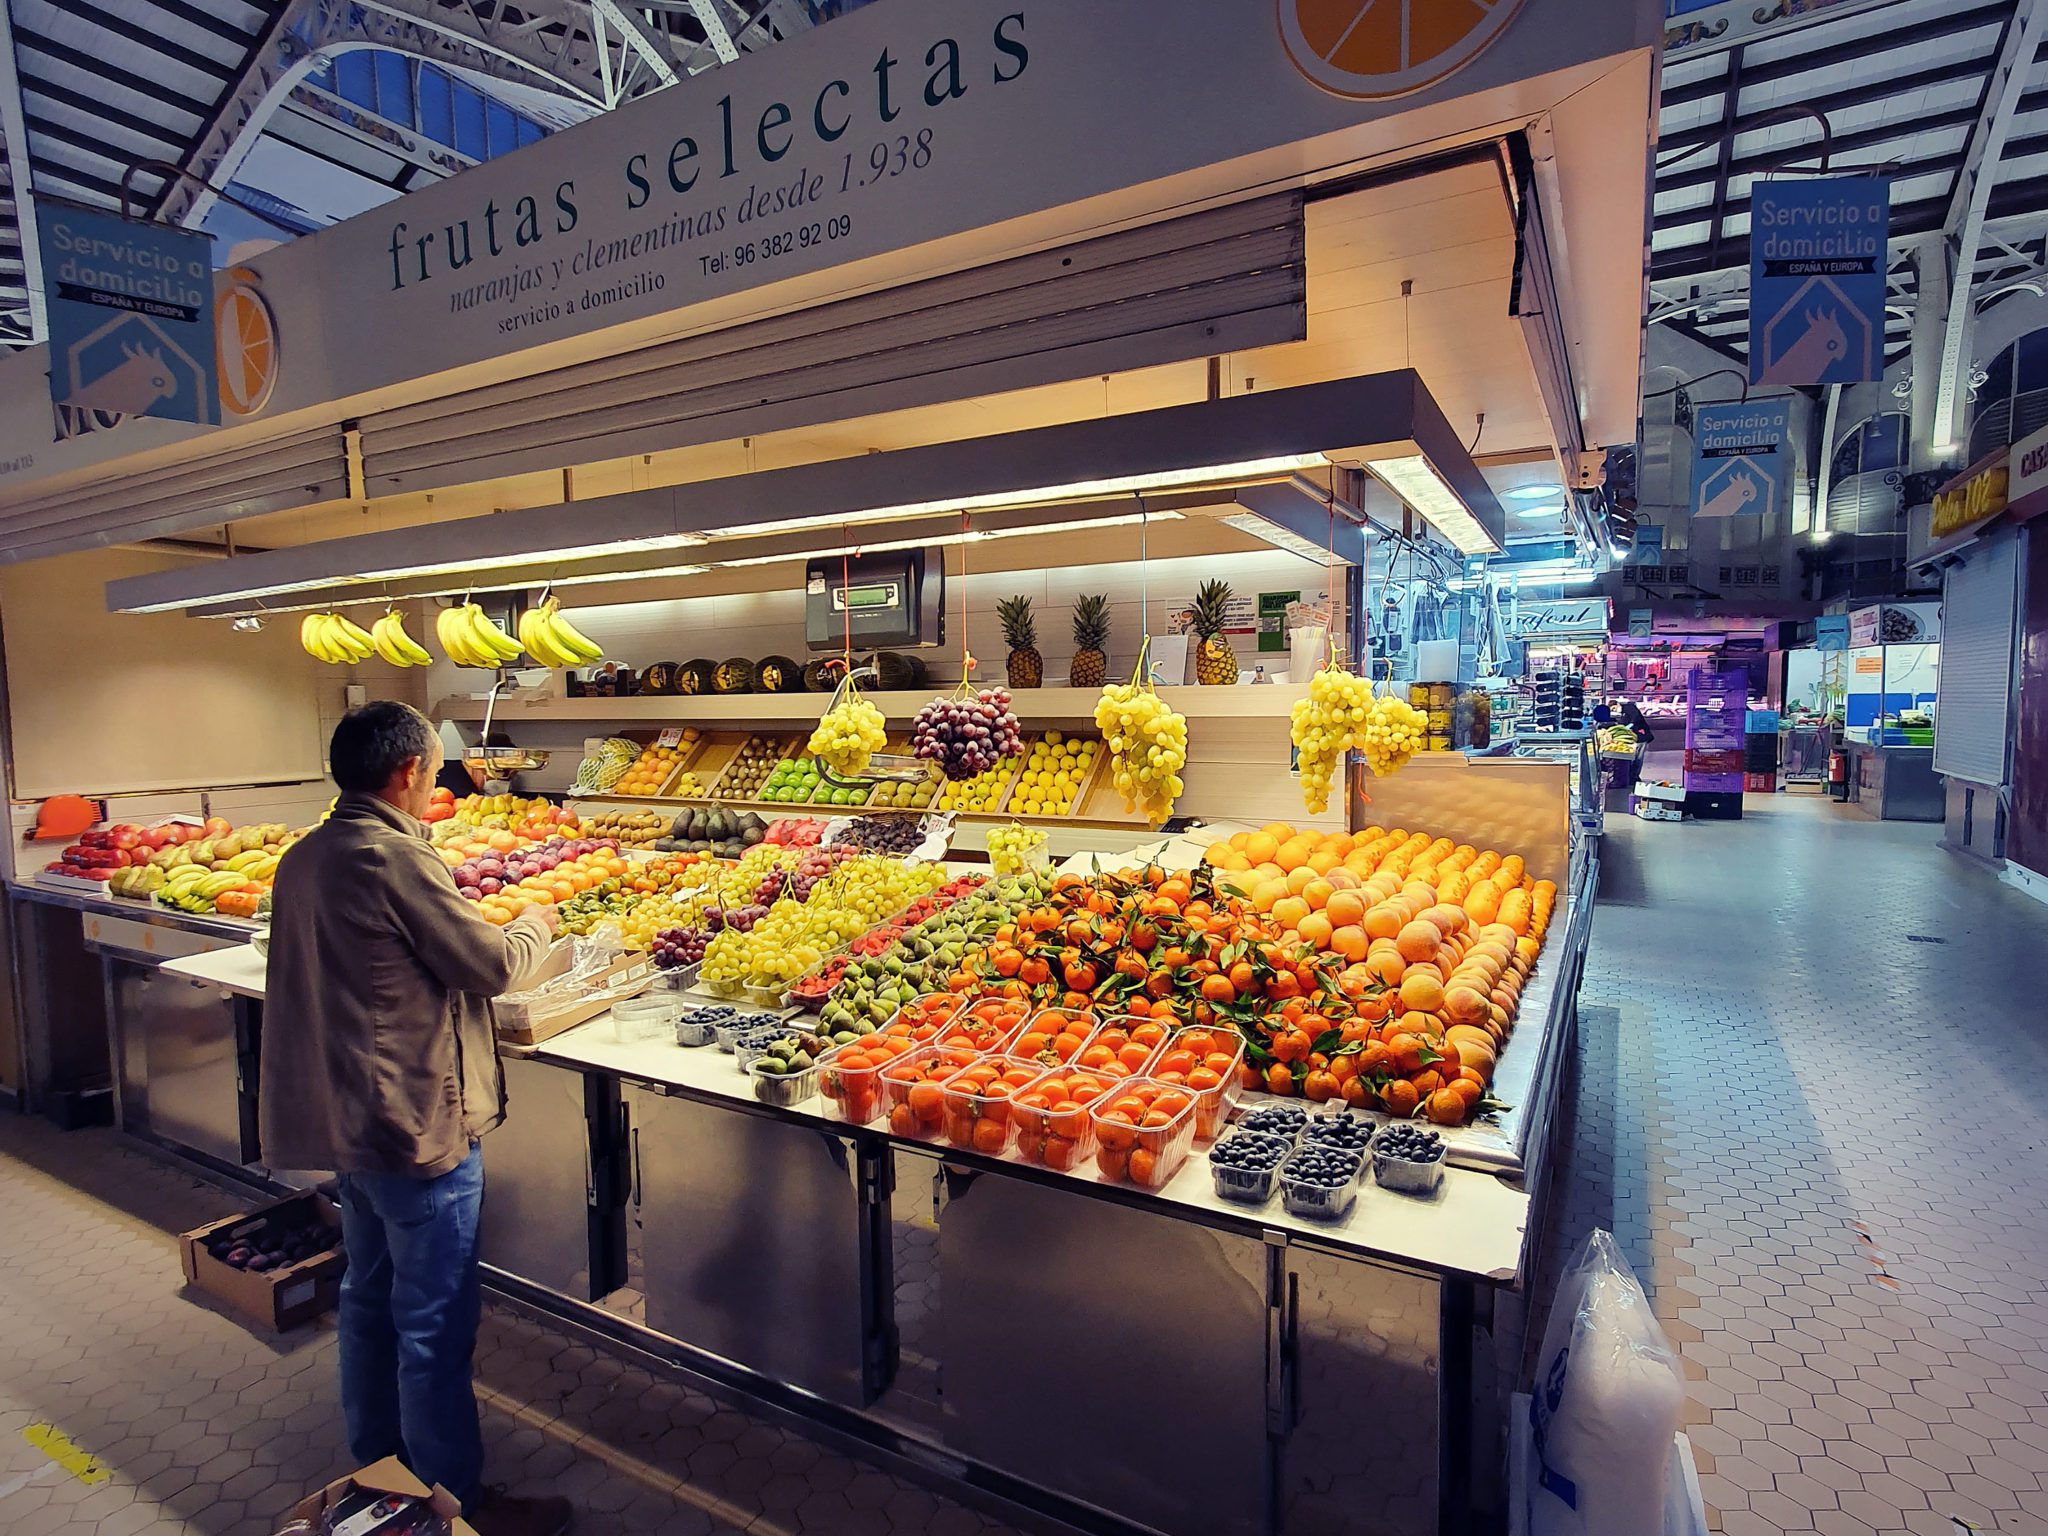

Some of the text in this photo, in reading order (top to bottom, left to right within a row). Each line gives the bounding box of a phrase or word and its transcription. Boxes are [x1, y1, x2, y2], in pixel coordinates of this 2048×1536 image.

[388, 12, 1030, 291] frutas selectas
[450, 128, 934, 313] naranjas y clementinas desde 1.938
[1761, 199, 1881, 226] Servicio a
[52, 224, 204, 279] Servicio a
[699, 214, 851, 277] Tel: 96 382 92 09
[1763, 229, 1877, 258] domicilio
[59, 257, 203, 306] domicilio
[1789, 260, 1864, 273] ESPAÑA Y EUROPA
[91, 292, 185, 319] ESPAÑA Y EUROPA
[498, 271, 665, 334] servicio a domicilio
[1702, 413, 1784, 432] Servicio a
[1703, 429, 1780, 448] domicilio
